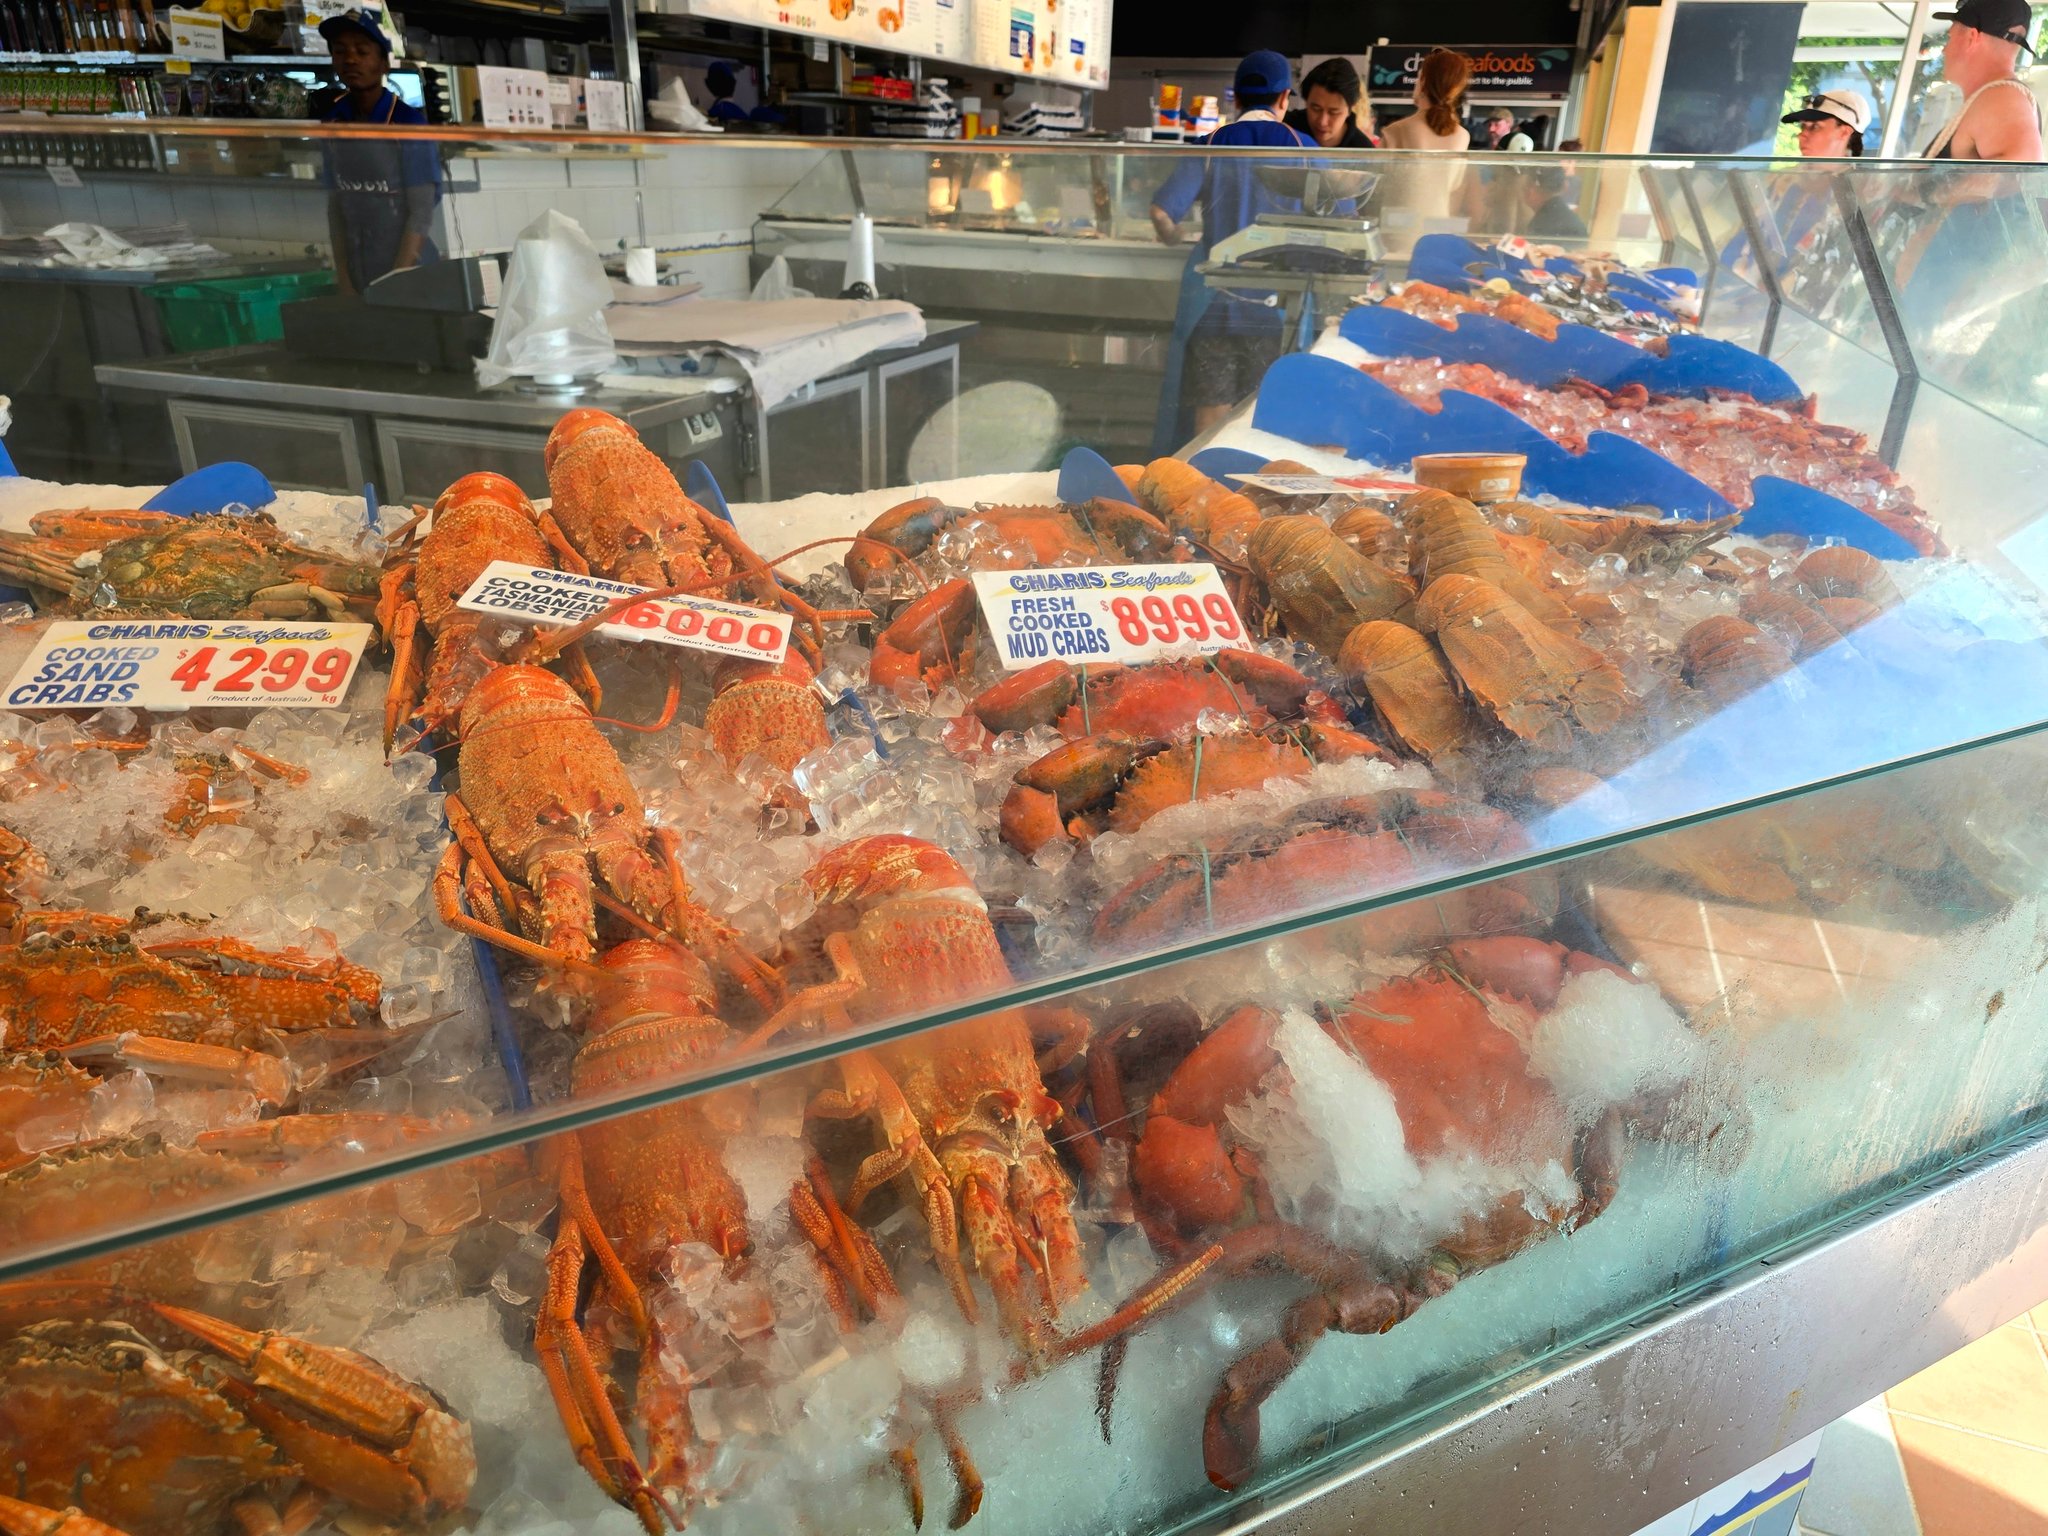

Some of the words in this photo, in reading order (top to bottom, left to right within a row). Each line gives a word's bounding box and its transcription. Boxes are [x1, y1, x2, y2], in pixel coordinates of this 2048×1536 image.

[1467, 52, 1535, 73] eafoods
[1506, 76, 1533, 87] public
[487, 577, 610, 605] COOKED
[530, 570, 646, 596] CHARIS
[1009, 572, 1107, 594] CHARIS
[1109, 571, 1196, 592] Seafoods
[480, 585, 606, 613] TASMANIAN
[1011, 596, 1075, 614] FRESH
[1008, 612, 1093, 632] COOKED
[87, 624, 213, 641] CHARIS
[212, 625, 333, 644] Seafoods
[1007, 632, 1050, 659] MUD
[1052, 628, 1111, 656] CRABS
[46, 647, 160, 662] COOKED
[663, 635, 704, 646] (Product
[717, 645, 762, 657] Australia)
[765, 651, 780, 660] kg
[1236, 640, 1250, 651] kg
[33, 662, 140, 683] SAND
[8, 683, 140, 705] CRABS
[206, 695, 252, 703] (Product
[254, 695, 264, 703] of
[264, 695, 313, 703] Australia)
[321, 693, 338, 704] kg
